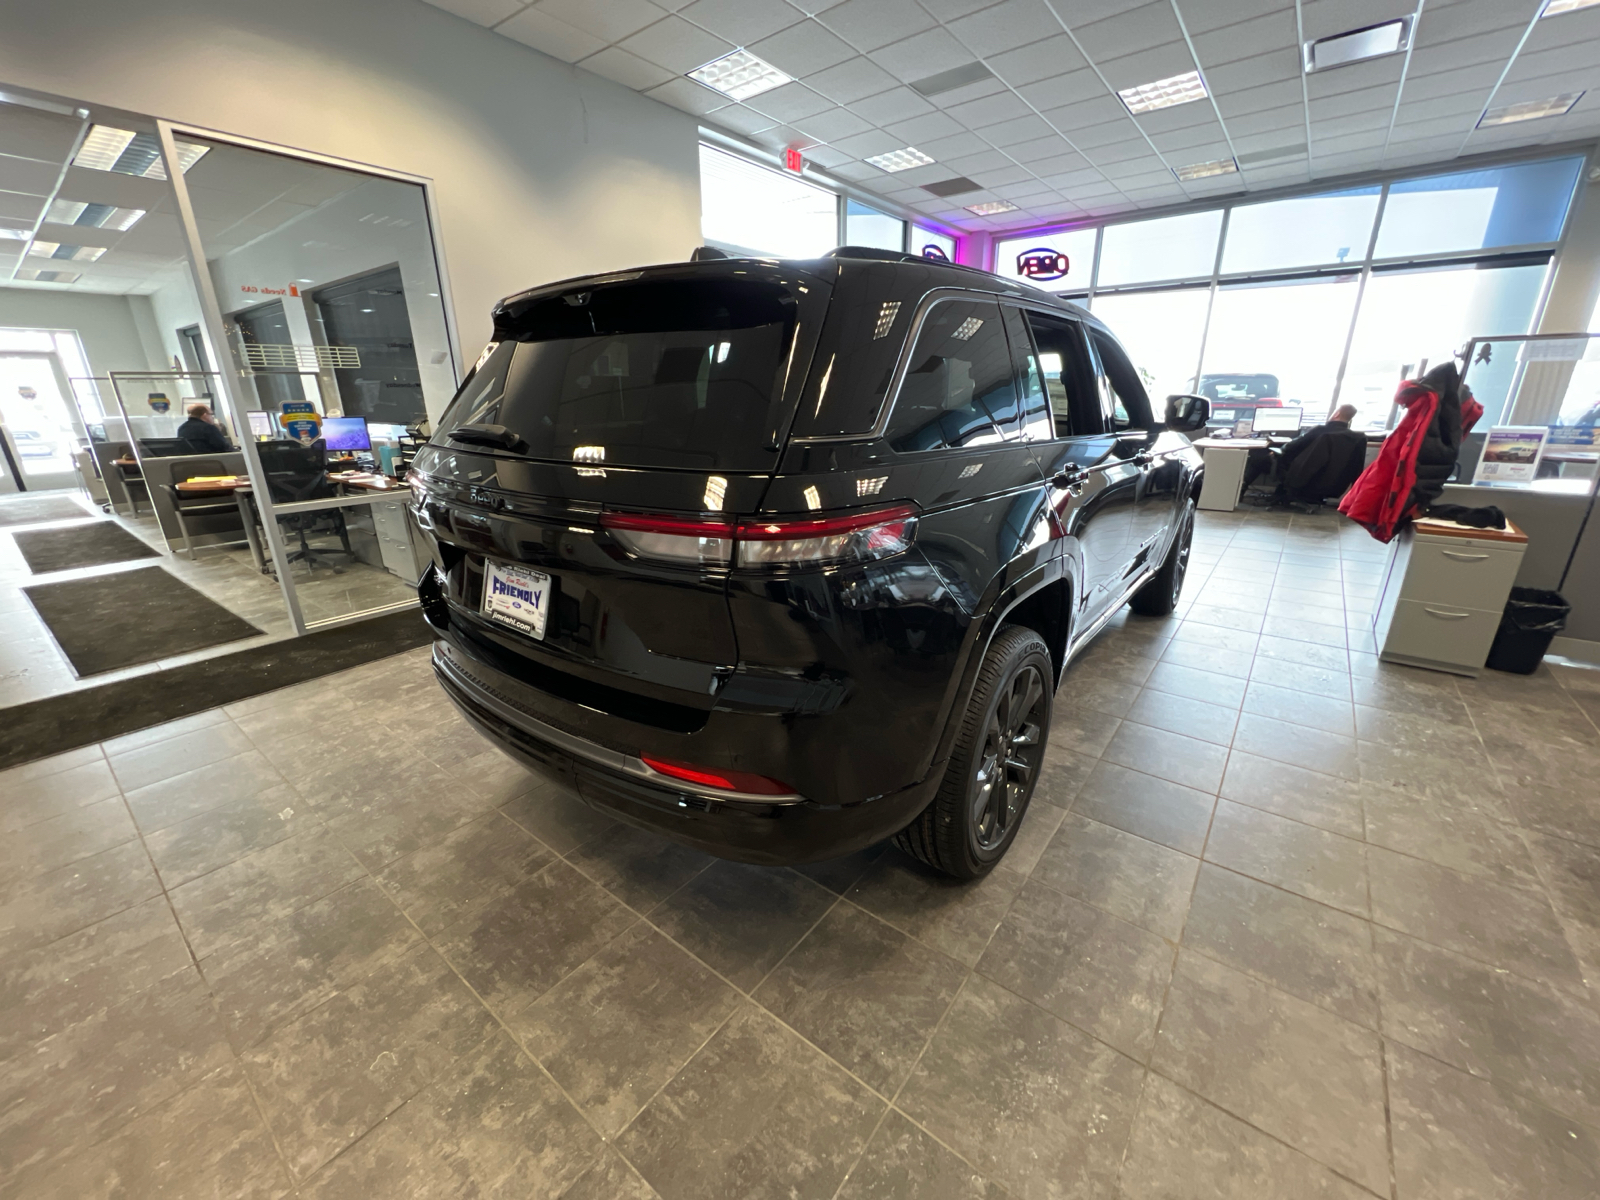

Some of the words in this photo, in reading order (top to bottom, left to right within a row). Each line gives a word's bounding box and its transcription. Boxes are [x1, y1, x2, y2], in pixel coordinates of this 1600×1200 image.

[787, 149, 802, 172] EXIT
[493, 575, 542, 610] FRIENDLY
[492, 611, 531, 631] jimriehl.com
